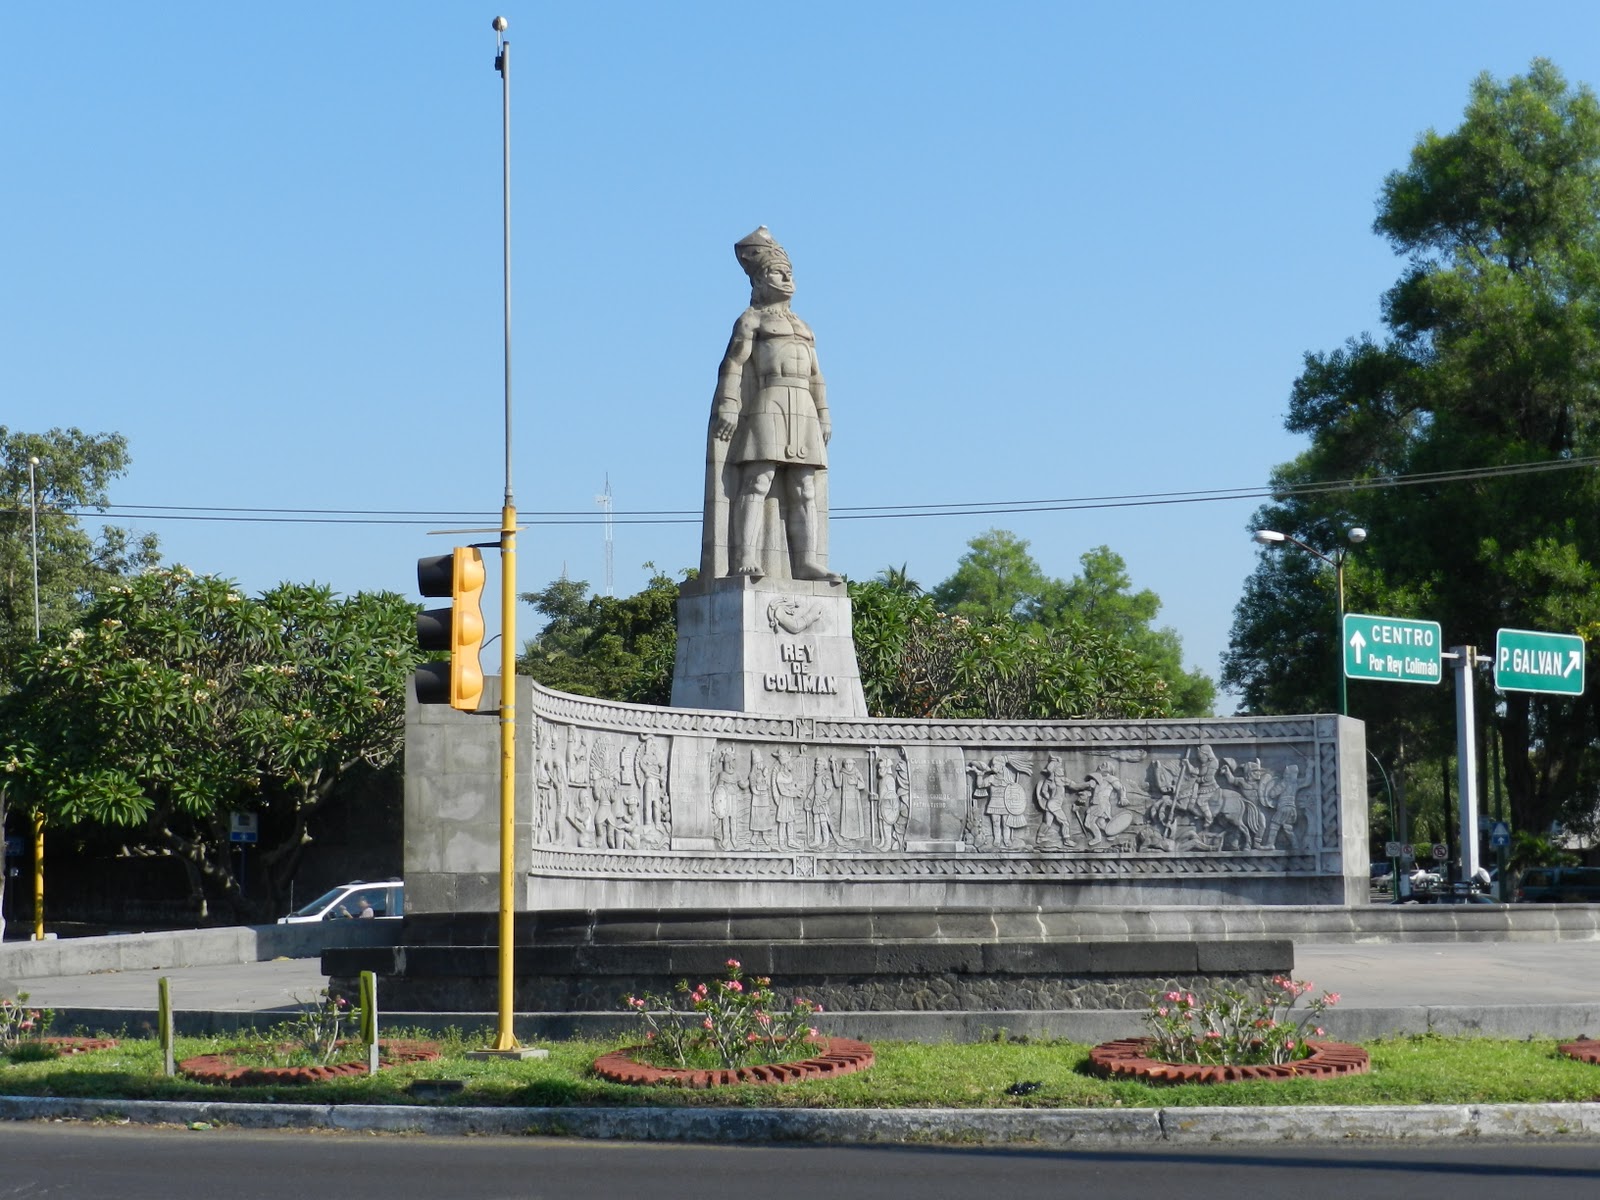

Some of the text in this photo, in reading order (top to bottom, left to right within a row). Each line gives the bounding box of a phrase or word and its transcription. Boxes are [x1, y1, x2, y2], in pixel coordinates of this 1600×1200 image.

[1372, 625, 1433, 646] CENTRO
[781, 644, 815, 662] REY
[1500, 646, 1562, 676] P. GALVAN
[791, 662, 810, 675] DE
[1369, 653, 1438, 677] Por Rey Colimán
[763, 673, 838, 695] COLIMAN
